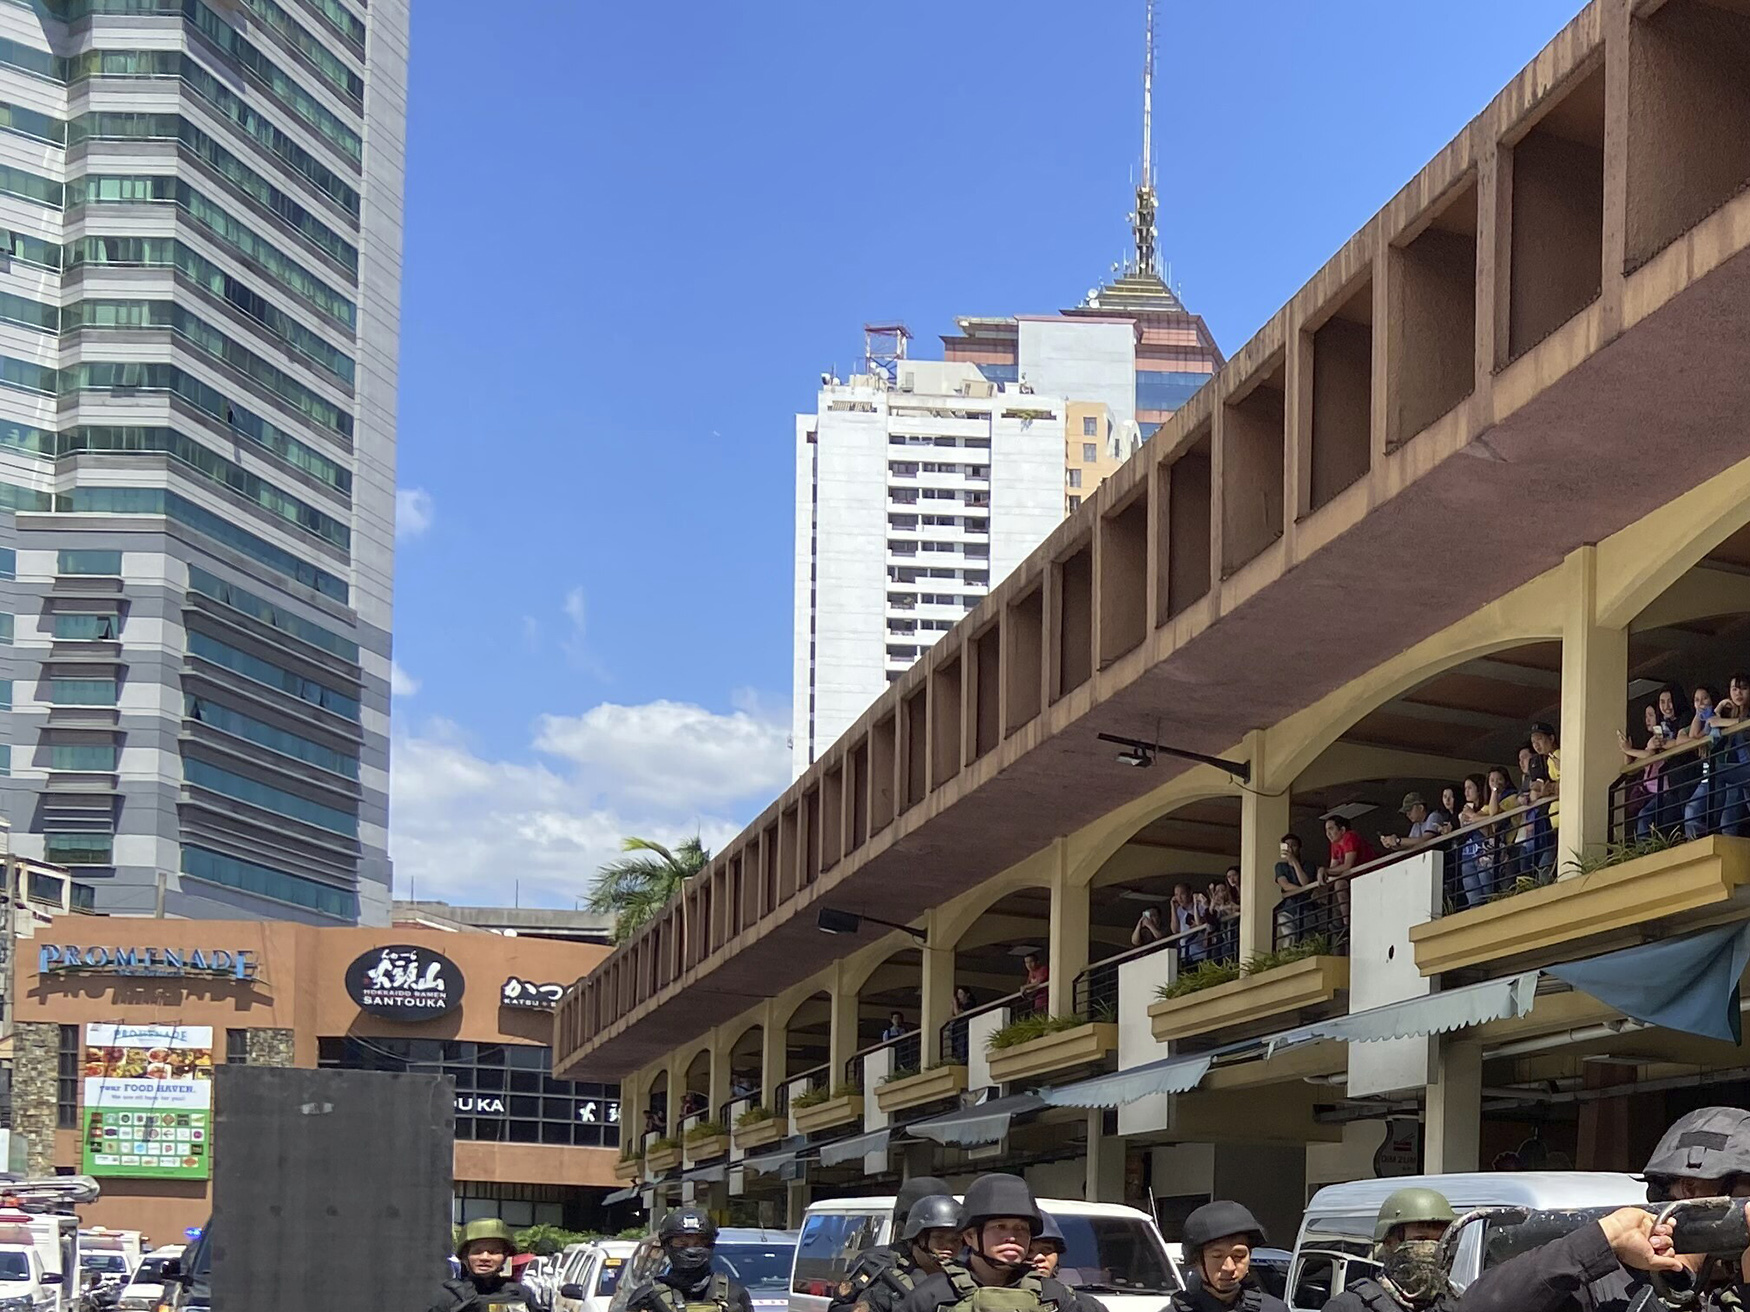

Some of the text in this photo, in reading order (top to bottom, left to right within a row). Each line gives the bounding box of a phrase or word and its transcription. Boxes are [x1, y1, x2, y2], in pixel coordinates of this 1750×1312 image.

[39, 943, 256, 979] PROMENADE
[414, 990, 447, 998] RAMEN
[504, 979, 574, 1001] かつ
[363, 996, 446, 1008] SANTOUKA
[503, 998, 539, 1006] KATSU
[455, 1097, 505, 1112] UKA
